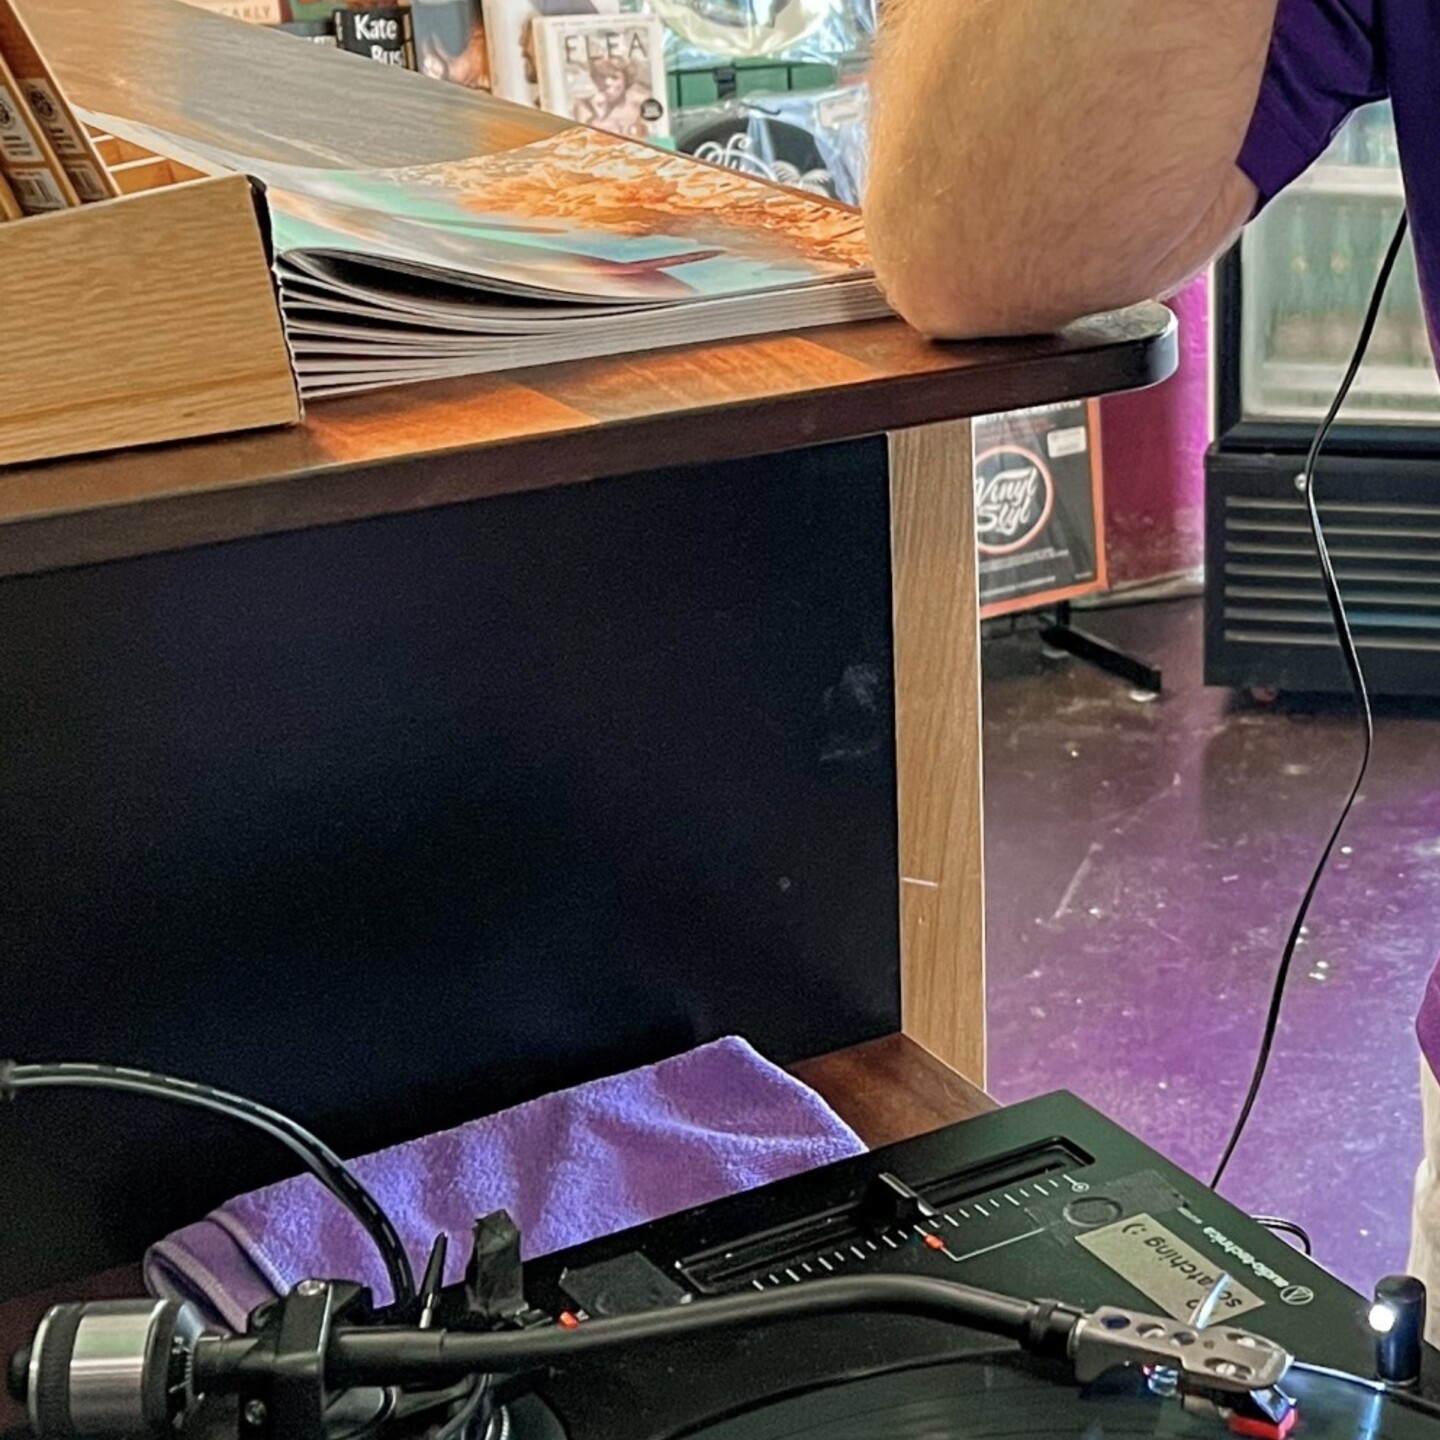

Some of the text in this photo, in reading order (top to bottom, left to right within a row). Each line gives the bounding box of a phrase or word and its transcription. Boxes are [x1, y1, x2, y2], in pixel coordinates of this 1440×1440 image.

[354, 14, 398, 40] Kate
[564, 31, 648, 63] FLEA
[975, 466, 1038, 508] Vinyl
[1144, 1236, 1242, 1309] scatching
[1202, 1226, 1290, 1288] audio-technica
